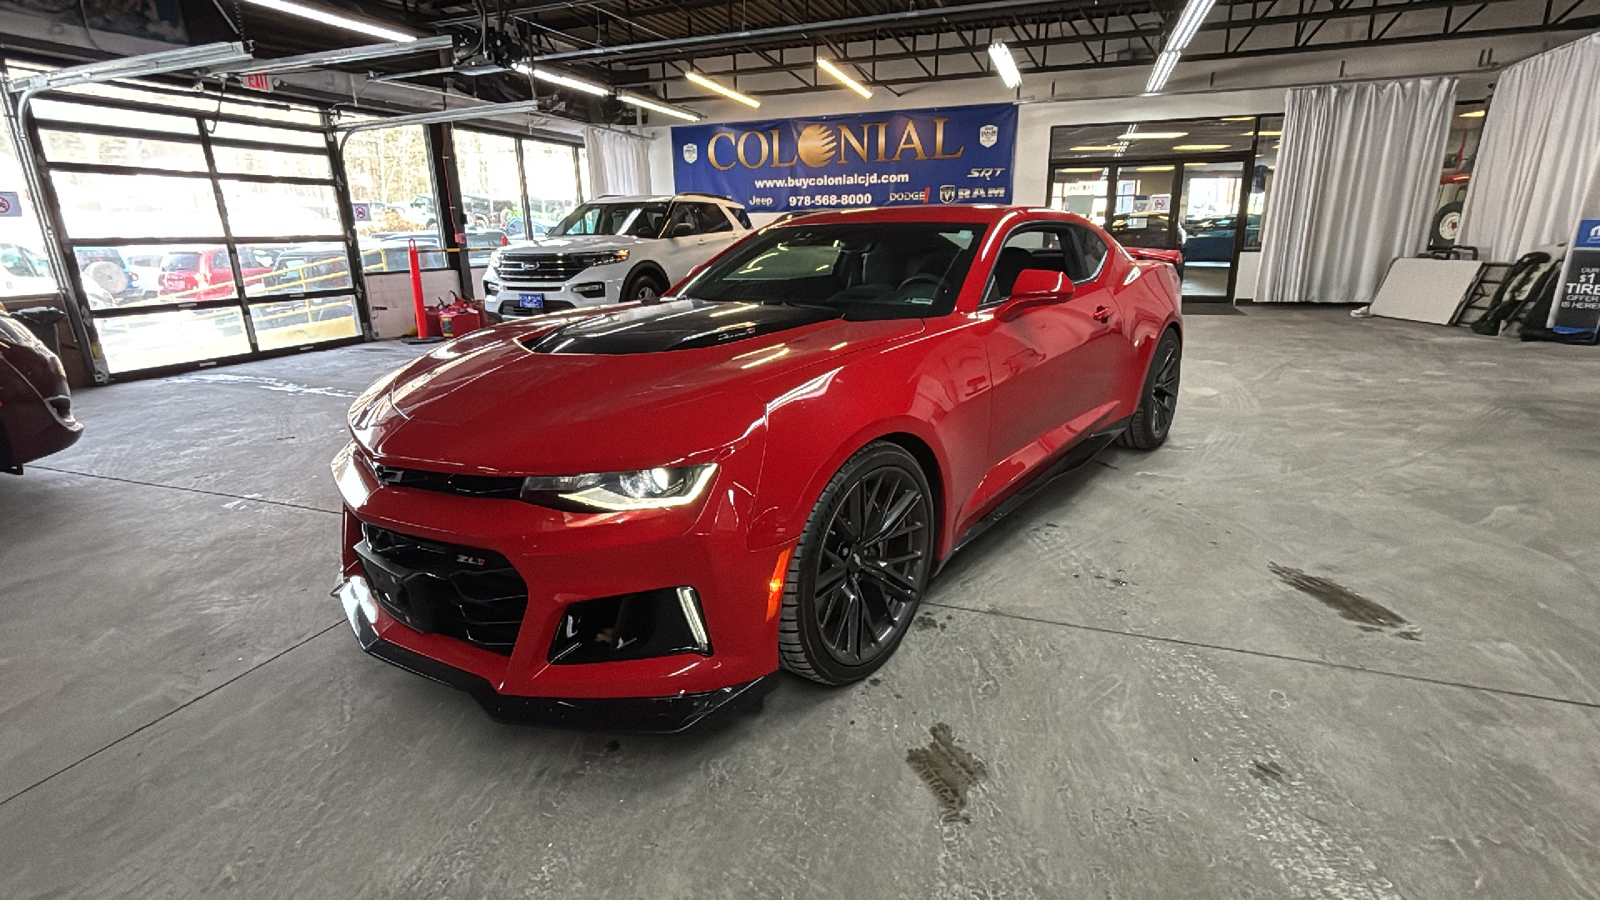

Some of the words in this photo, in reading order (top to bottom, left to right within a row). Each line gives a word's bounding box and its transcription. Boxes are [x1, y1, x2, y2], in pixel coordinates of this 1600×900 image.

[707, 118, 965, 171] COLONIAL
[967, 167, 1006, 181] SRT
[754, 173, 910, 189] www.buycolonialcjd.com
[890, 191, 926, 201] DODGE
[957, 187, 1006, 199] RAM
[749, 195, 773, 207] Jeep
[788, 193, 872, 206] 978-568-8000
[1566, 295, 1599, 303] OFFER
